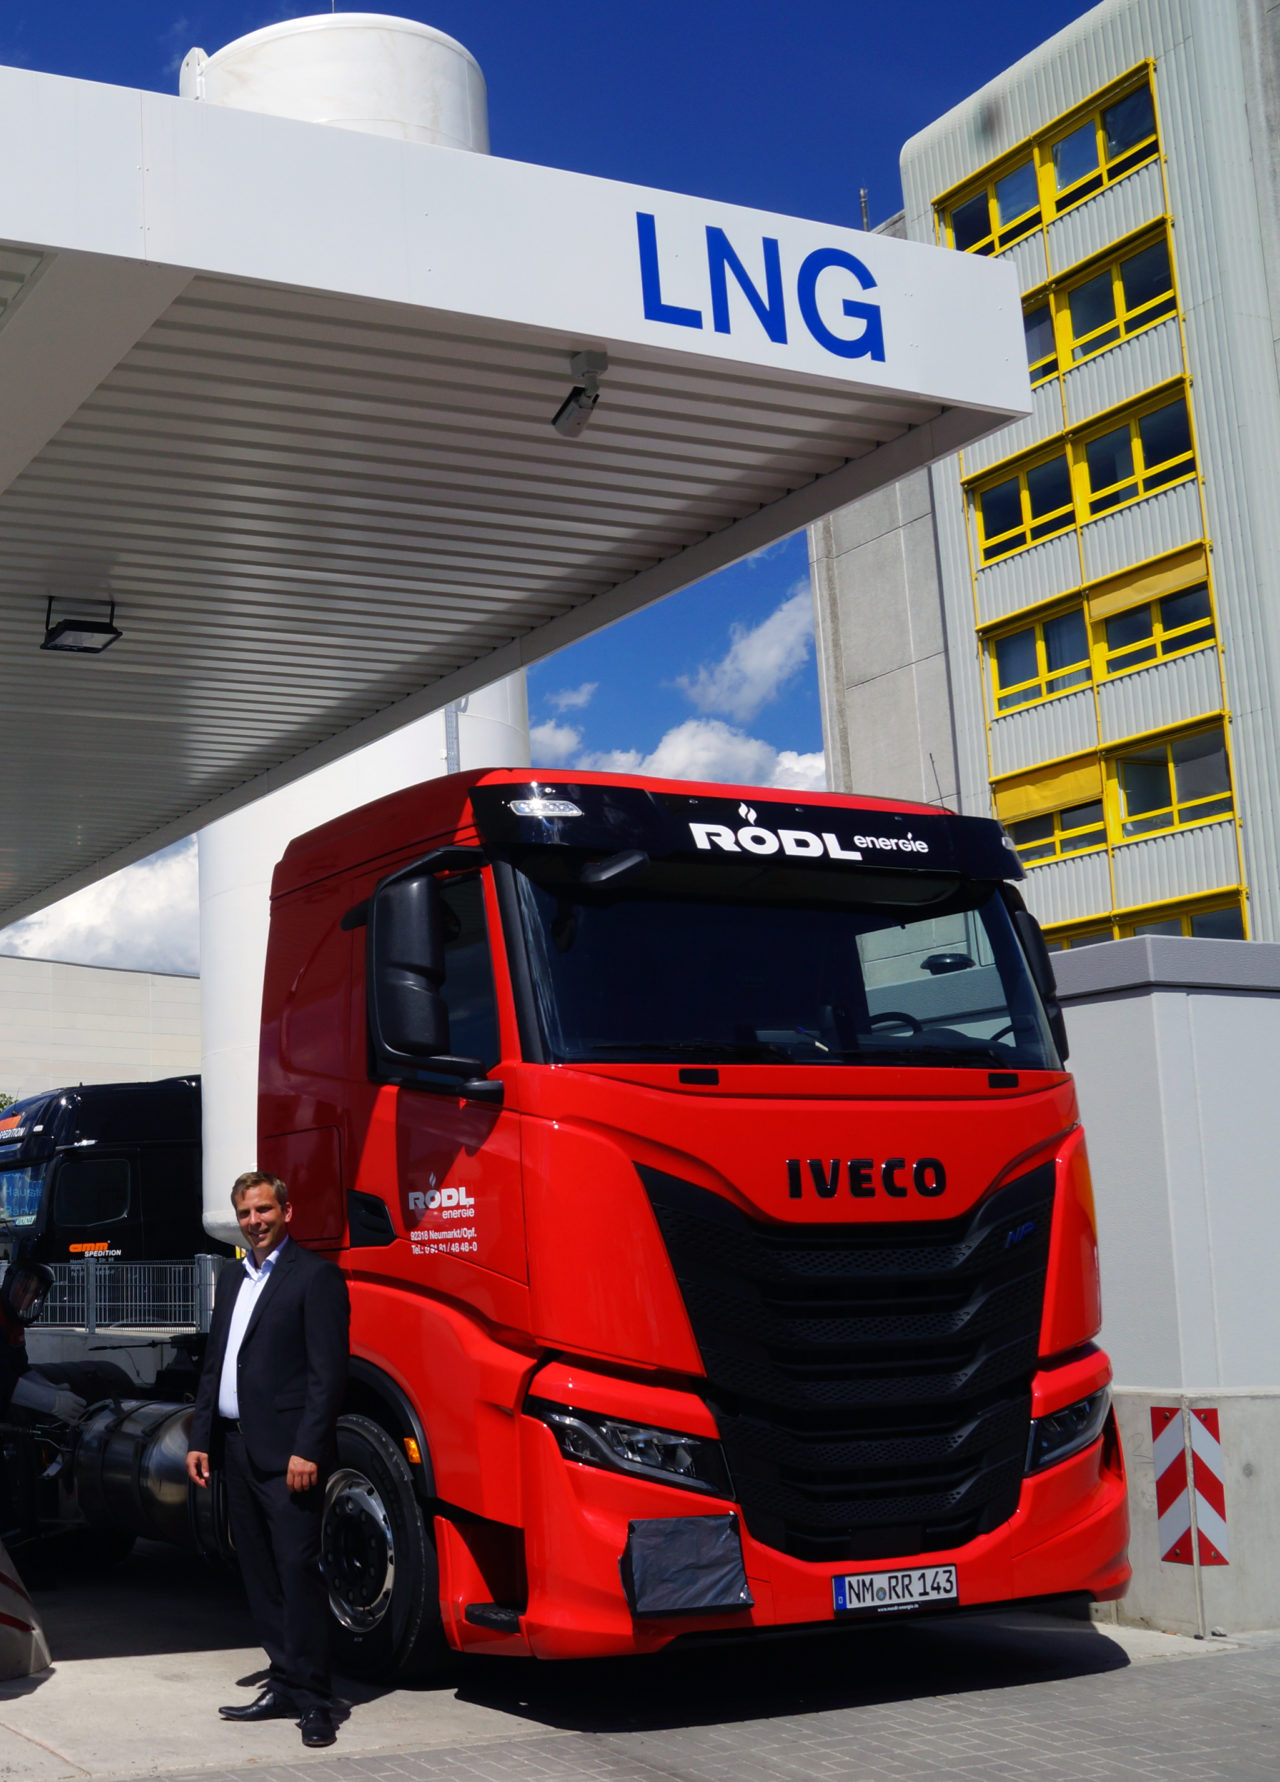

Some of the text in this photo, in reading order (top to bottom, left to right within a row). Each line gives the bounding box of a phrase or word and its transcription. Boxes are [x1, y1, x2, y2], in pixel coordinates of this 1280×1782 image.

[636, 211, 886, 363] LNG
[854, 832, 929, 853] energie
[786, 1158, 946, 1199] IVECO
[442, 1207, 475, 1219] energie
[84, 1249, 122, 1257] SPEDITION
[848, 1569, 954, 1604] NM RR 143
